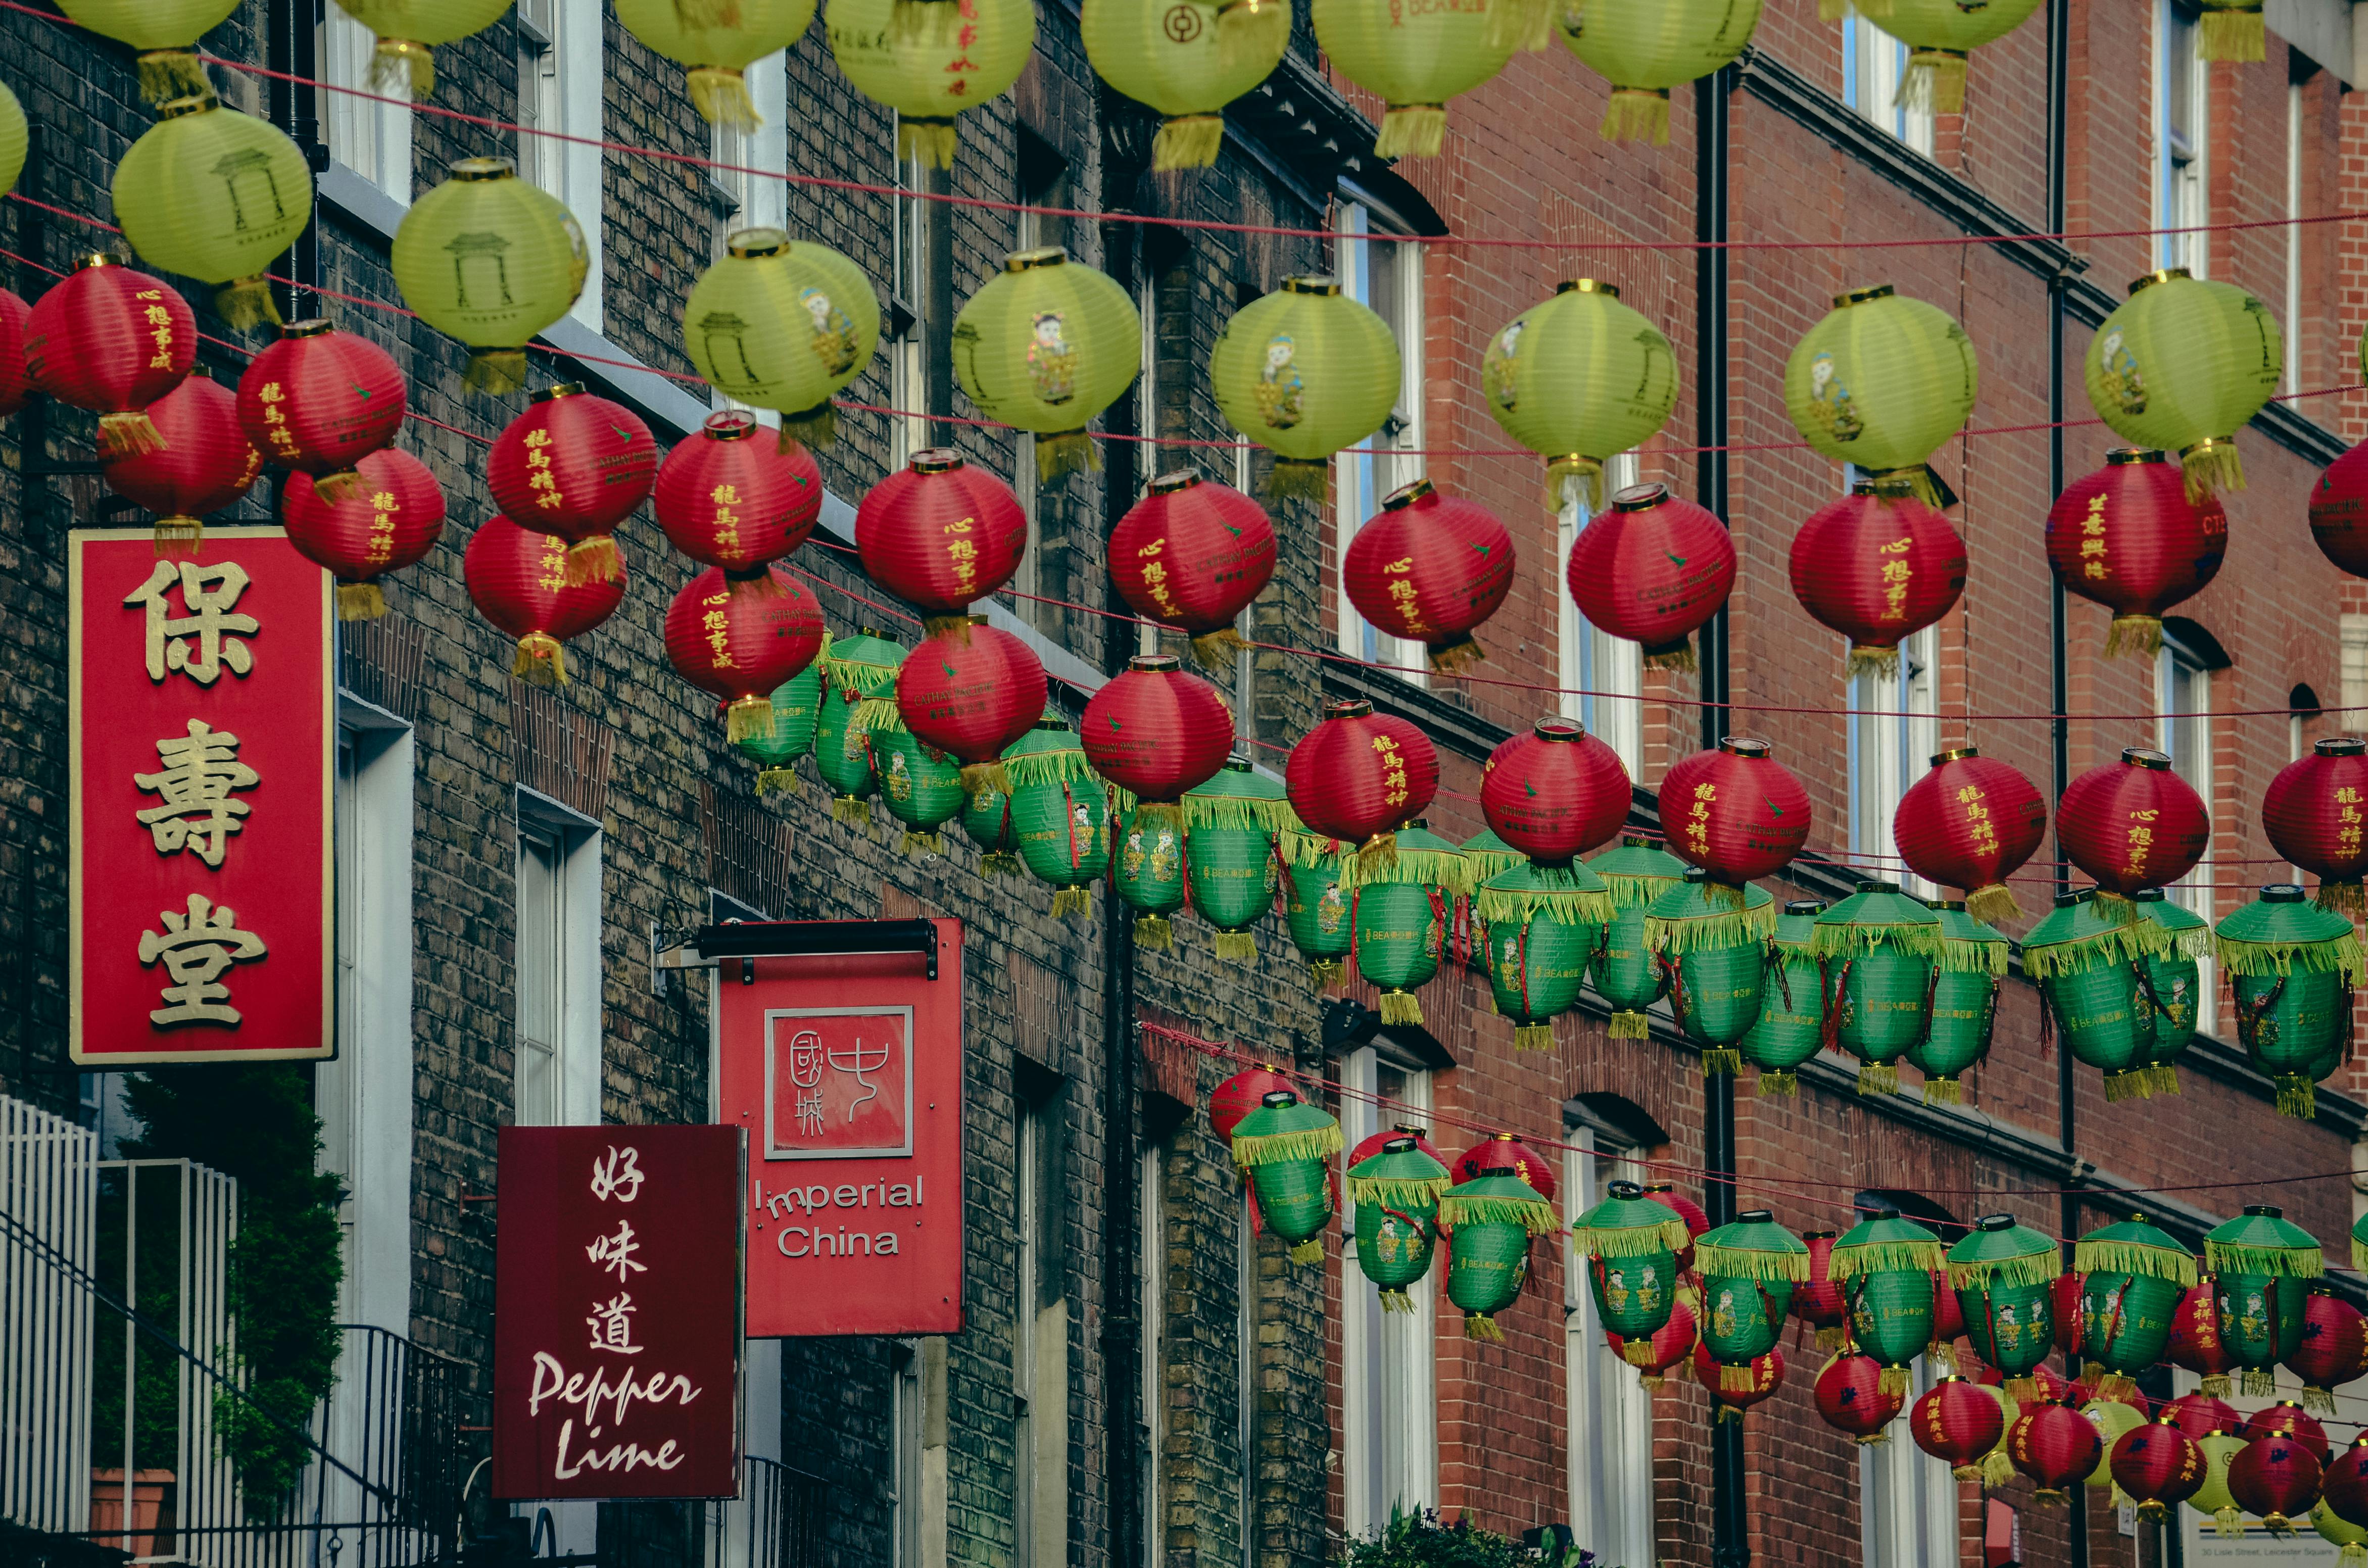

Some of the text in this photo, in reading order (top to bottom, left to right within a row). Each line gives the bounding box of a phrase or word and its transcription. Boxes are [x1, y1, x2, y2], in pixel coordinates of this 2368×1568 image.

[135, 288, 173, 369] 心想事成
[523, 428, 563, 509] 龍馬精神
[364, 492, 401, 564] 龍馬精神
[710, 484, 746, 559] 龍馬精神
[2080, 492, 2111, 580] 生意興隆
[538, 534, 566, 594] 馬精神
[943, 516, 979, 595] 心想事成
[1137, 537, 1183, 617] 心想事成
[1879, 536, 1913, 620] 心想事成
[761, 608, 802, 623] CATHAY
[1383, 557, 1431, 633] 心想事成
[702, 591, 740, 669] 心想事成
[914, 680, 996, 707] CATHAY PACIFIC
[1120, 738, 1161, 753] PACIFIC
[1370, 734, 1409, 807] 龍馬精神
[122, 559, 267, 1026] 保壽堂
[1686, 782, 1717, 856] 龍馬精神
[1956, 785, 1999, 857] 龍馬精神
[2334, 786, 2364, 859] 龍馬精神
[1735, 820, 1778, 838] CATHAY
[2123, 809, 2159, 880] 心想事成
[1212, 869, 1229, 878] BEA
[1231, 868, 1258, 878] 東亞銀行
[1373, 930, 1389, 941] BEA
[2080, 1017, 2099, 1028] BEA
[1352, 1153, 1366, 1164] CT
[1515, 1159, 1532, 1188] 生意
[754, 1175, 923, 1220] Imperial
[585, 1145, 648, 1355] 好味道
[777, 1226, 899, 1257] China
[1757, 1316, 1767, 1325] BE
[2193, 1297, 2215, 1348] 吉祥如意
[528, 1350, 702, 1427] Pepper
[1759, 1352, 1774, 1391] 意興隆
[555, 1418, 685, 1480] Lime
[2264, 1548, 2301, 1556] Leicester
[2304, 1548, 2333, 1557] Square
